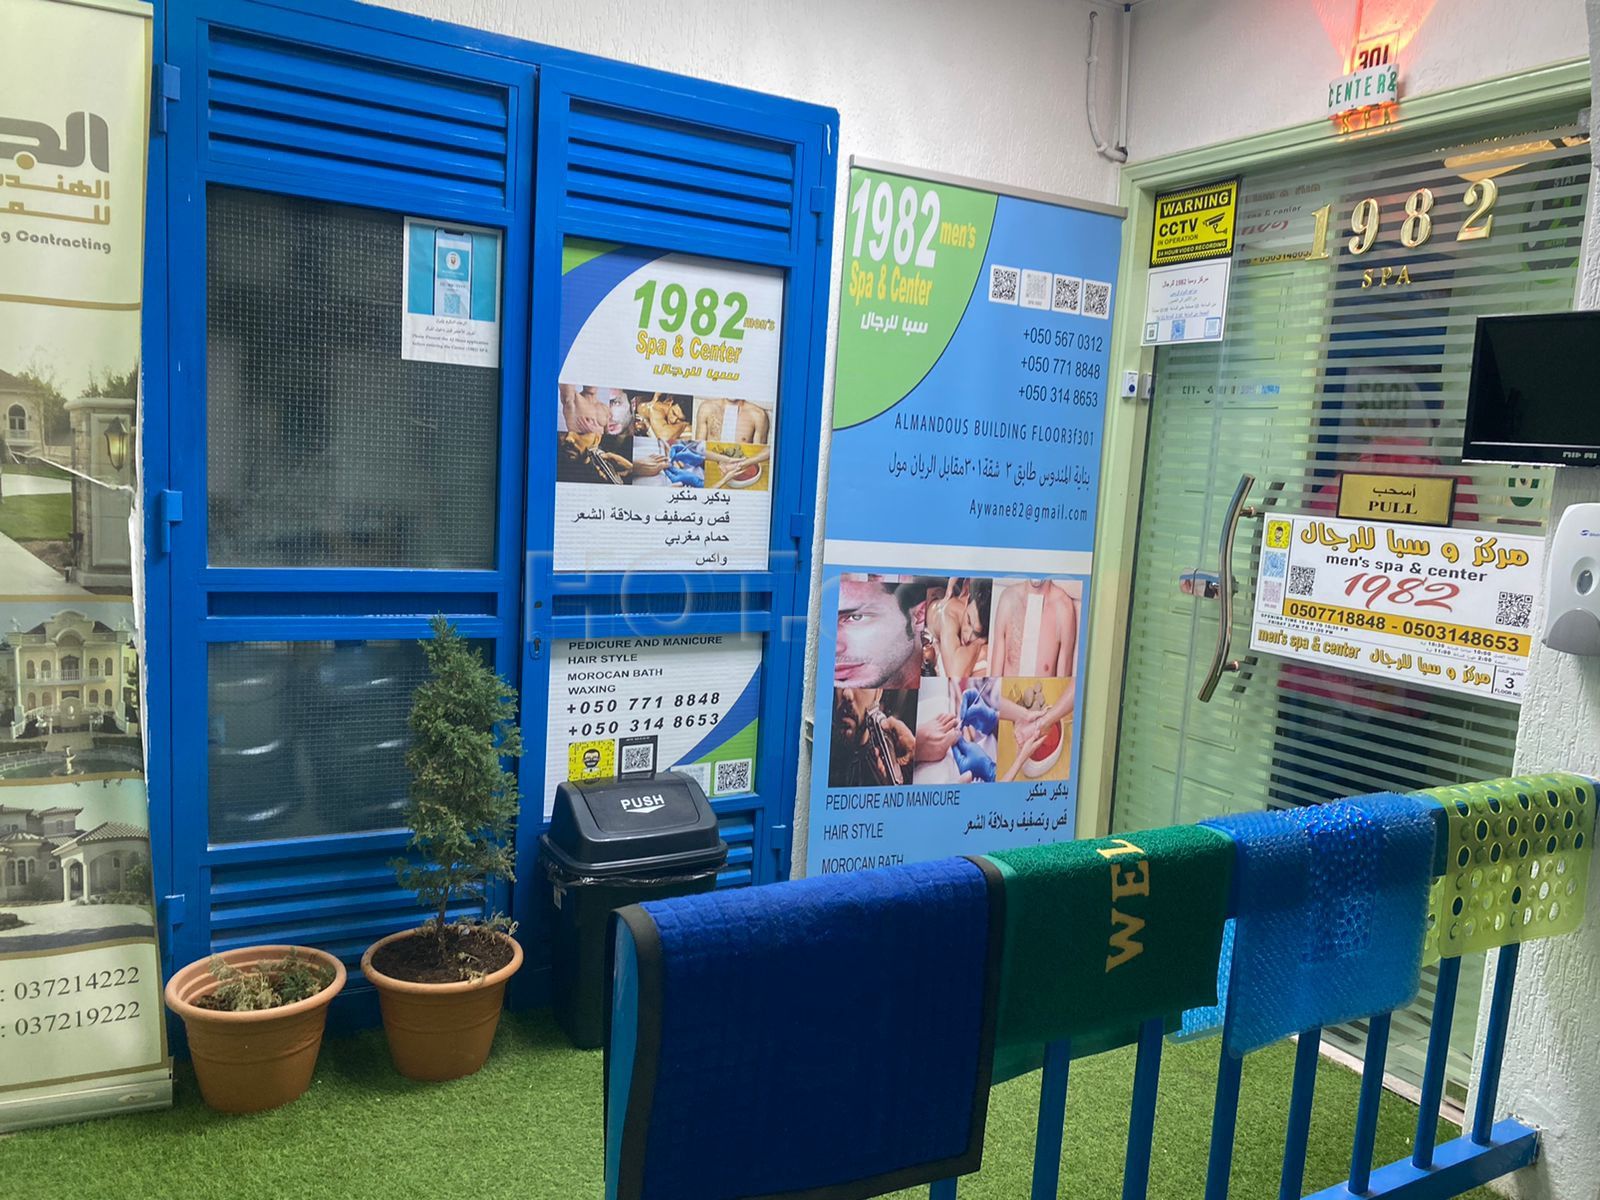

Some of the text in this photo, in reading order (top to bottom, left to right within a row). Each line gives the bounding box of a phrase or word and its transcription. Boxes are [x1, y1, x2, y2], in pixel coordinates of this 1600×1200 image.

[1163, 191, 1229, 216] WARNING
[851, 178, 977, 269] 1982 men's
[1159, 217, 1198, 238] CCTV
[1305, 178, 1498, 261] 1982
[16, 230, 111, 254] Contracting
[849, 259, 933, 307] Spa & Center
[1361, 264, 1413, 290] SPA
[634, 280, 748, 341] 1982
[860, 311, 899, 334] للرجال
[636, 330, 743, 364] Spa & Center
[1023, 327, 1104, 353] +050 567 0312
[1021, 355, 1101, 380] +050 771 8848
[1018, 384, 1098, 408] +050 314 8653
[895, 412, 969, 436] ALMANDOUS
[973, 419, 1027, 441] BUILDING
[888, 451, 907, 478] مول
[911, 452, 936, 480] الريان
[1013, 460, 1036, 487] طابق
[1372, 484, 1417, 499] أسحب
[571, 507, 730, 526] قص وتصفيف وحلاقة الشعر
[969, 498, 1088, 523] Aywane82@gmail.com
[1368, 500, 1418, 516] PULL
[664, 530, 729, 546] حمام مغربي
[1300, 521, 1530, 570] مركز و سبا للرجال
[1326, 553, 1488, 583] men's spa & center
[1344, 572, 1461, 613] 1982
[1290, 602, 1386, 631] 0507718848
[1403, 620, 1520, 653] 0503148653
[568, 635, 723, 651] PEDICURE AND MANICURE
[1258, 629, 1361, 660] men's spa & center
[568, 653, 638, 665] HAIR STYLE
[1369, 648, 1491, 686] مركز و سبا للرجال
[567, 668, 663, 681] MOROCAN BATH
[1504, 677, 1515, 689] 3
[568, 684, 616, 695] WAXING
[567, 692, 720, 714] +050 771 8848
[568, 712, 719, 737] +050 314 8653
[620, 794, 665, 811] PUSH
[826, 790, 960, 810] PEDICURE AND MANICURE
[823, 822, 884, 840] HAIR STYLE
[988, 811, 1014, 832] وحلاقة
[1016, 811, 1049, 831] وتصفيف
[821, 857, 876, 875] MOROCAN
[14, 966, 140, 1000] 037214222
[15, 1001, 141, 1036] 037219222
